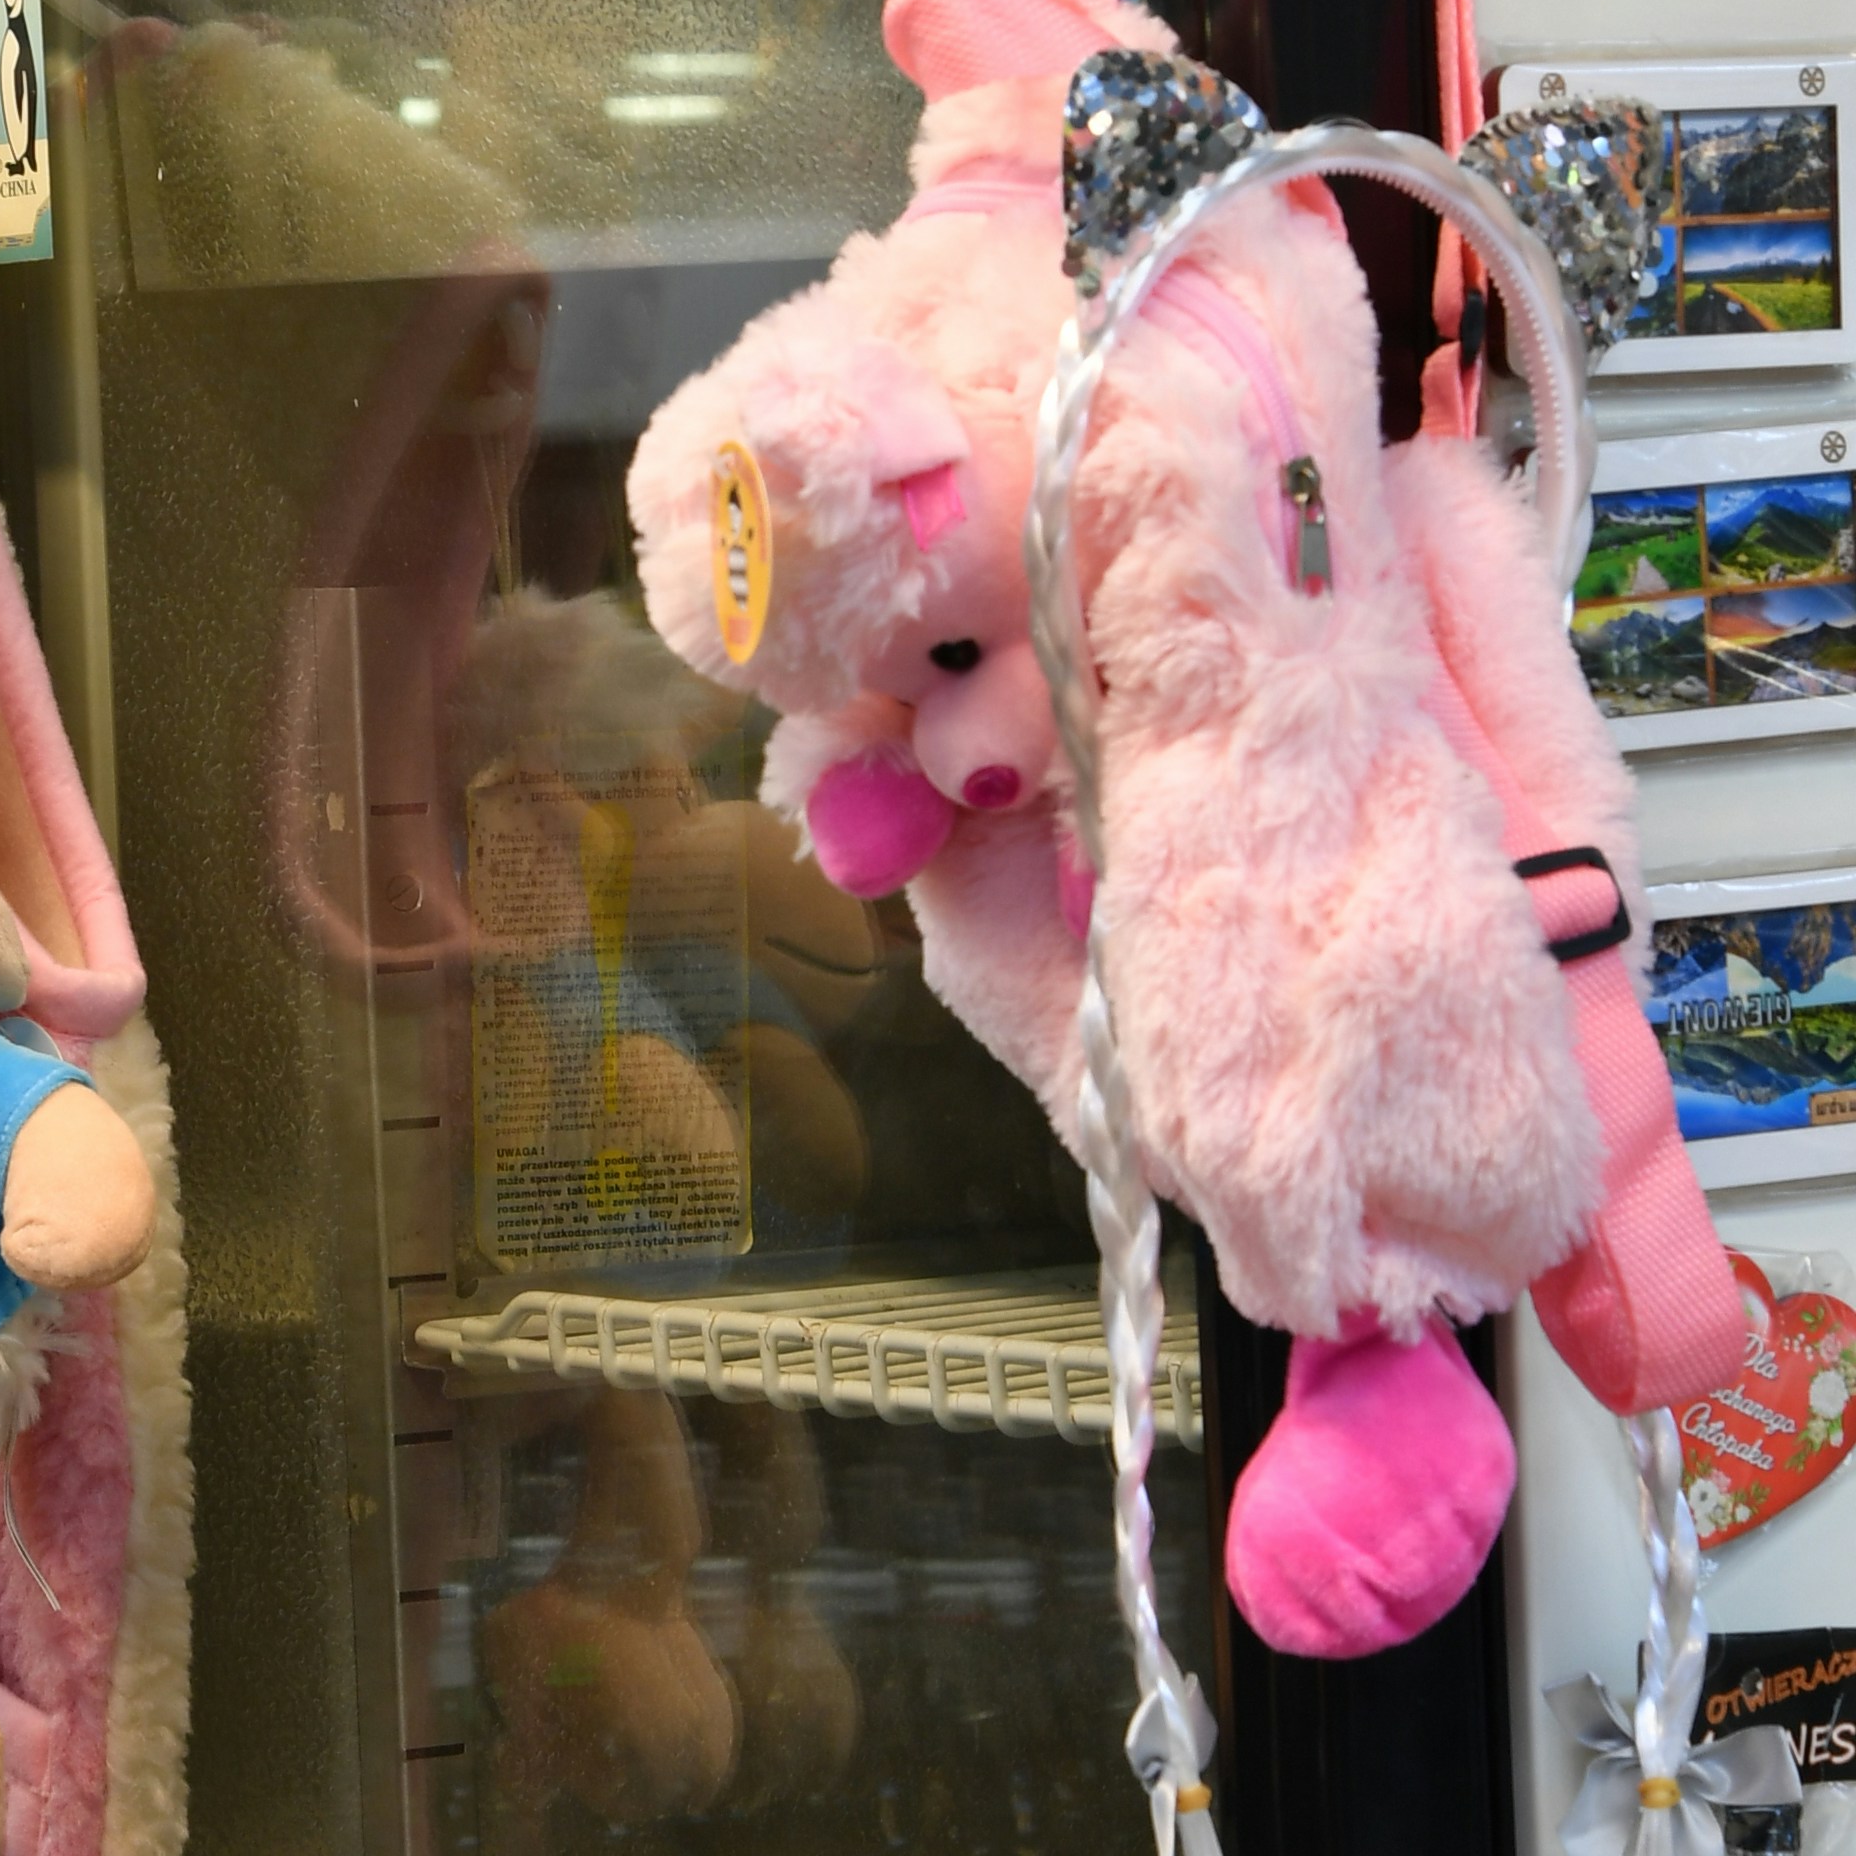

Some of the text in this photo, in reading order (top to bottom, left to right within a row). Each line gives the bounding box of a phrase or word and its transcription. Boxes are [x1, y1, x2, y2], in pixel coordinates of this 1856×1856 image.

[1667, 992, 1793, 1037] GIEWONT
[496, 1162, 515, 1173] Nie
[604, 1170, 621, 1180] nie
[567, 1184, 602, 1196] takich
[586, 1198, 605, 1210] lub
[572, 1213, 590, 1225] się
[597, 1210, 627, 1223] wody
[648, 1208, 673, 1220] tacy
[669, 1219, 708, 1232] usterki
[709, 1219, 721, 1229] te
[723, 1218, 741, 1228] nie
[1743, 1331, 1780, 1380] Dla
